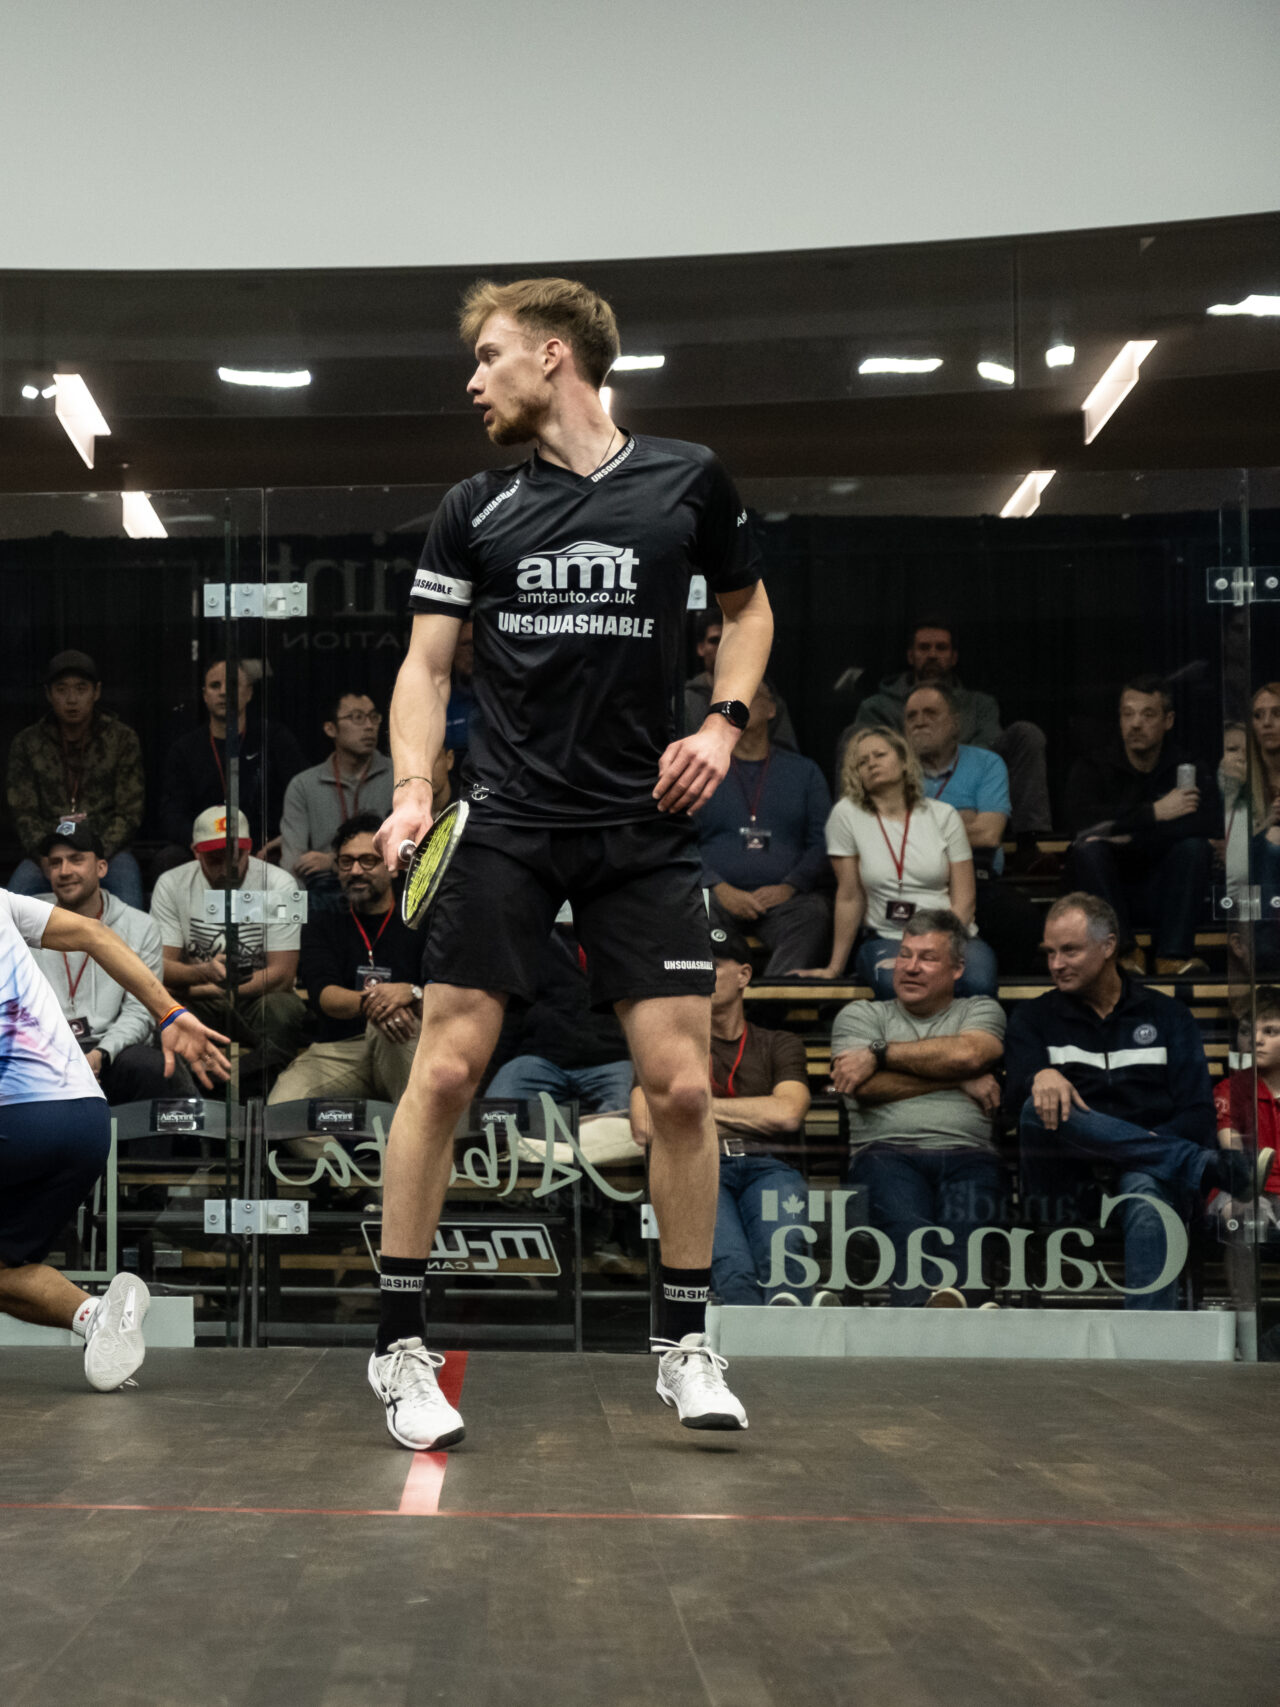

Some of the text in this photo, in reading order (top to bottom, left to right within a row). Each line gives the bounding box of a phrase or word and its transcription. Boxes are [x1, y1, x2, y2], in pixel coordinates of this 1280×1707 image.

[516, 548, 640, 591] amt
[517, 590, 636, 605] amtauto.co.uk
[498, 612, 655, 638] UNSQUASHABLE
